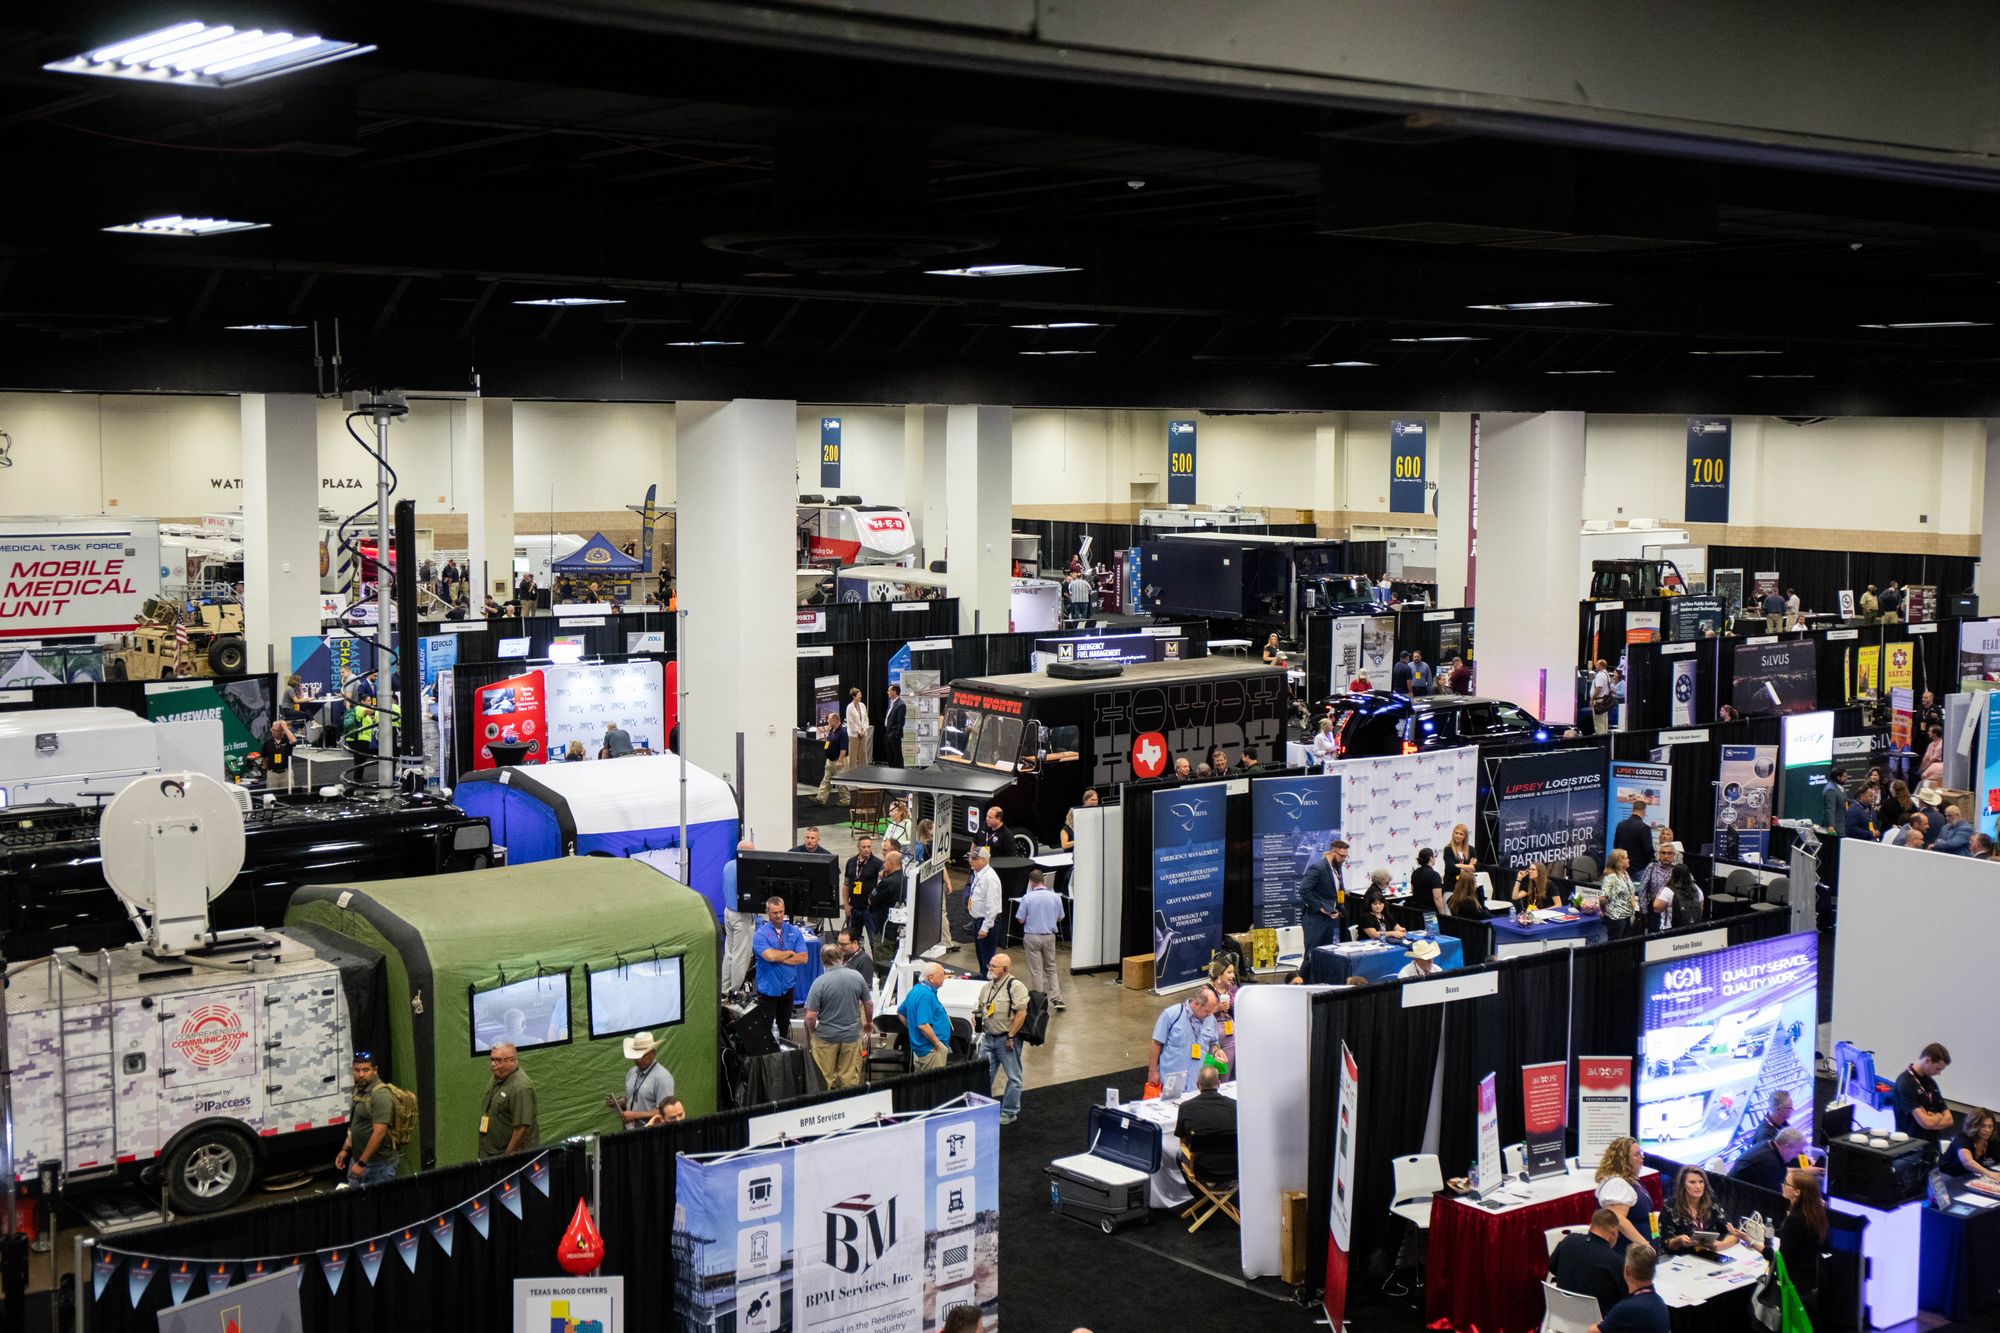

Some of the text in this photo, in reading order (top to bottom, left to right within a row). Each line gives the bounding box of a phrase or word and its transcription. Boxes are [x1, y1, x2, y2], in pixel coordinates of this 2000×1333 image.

[824, 444, 839, 462] 200
[1172, 452, 1193, 473] 500
[1395, 455, 1421, 478] 600
[1692, 458, 1724, 483] 700
[211, 478, 363, 489] WAT PLAZA
[10, 560, 124, 578] MOBILE
[4, 579, 137, 598] MEDICAL
[0, 600, 70, 618] UNIT
[439, 640, 453, 648] BOLD
[1077, 643, 1105, 651] EMERGENCY
[340, 640, 350, 667] CHA
[350, 640, 360, 675] MAKE
[1077, 649, 1121, 659] FUEL MANAGEMENT
[331, 640, 341, 690] HAPPEN
[953, 691, 1023, 715] FORT WORTH
[168, 707, 221, 723] SAFEWARE
[233, 741, 248, 750] Heroes
[1839, 740, 1857, 748] weaver
[1635, 769, 1664, 777] LOGISTICS
[1504, 792, 1536, 800] RESPONSE
[1542, 787, 1573, 796] RECOVERY
[1574, 783, 1601, 791] SERVICES
[1505, 774, 1601, 794] LIPSEY LOGISTICS
[937, 831, 950, 855] 40
[1504, 826, 1594, 853] POSITIONED FOR
[1160, 848, 1219, 863] EMERGENCY MANAGEMENT
[1510, 844, 1587, 869] PARTNERSHIP
[1160, 866, 1218, 881] GOVERNMENT OPERATIONS
[1169, 878, 1178, 886] AND
[1166, 892, 1212, 905] GRANT MANAGEMENT
[1170, 913, 1199, 923] TECHNOLOGY
[1176, 918, 1202, 927] INNOVATION
[1173, 933, 1206, 945] GRANT WRITING
[1672, 940, 1703, 952] Safeside Global
[1722, 954, 1809, 983] QUALITY SERVICE
[1722, 971, 1799, 997] QUALITY WORK
[171, 1031, 249, 1049] COMMUNICATION
[175, 1026, 241, 1042] COMPREHENSIVE
[171, 1088, 233, 1103] Satellite Powered by:
[204, 1097, 251, 1113] IPaccess
[800, 1110, 846, 1128] BPM Services
[750, 1203, 772, 1212] Dumpsters
[566, 1252, 594, 1260] READINESS
[529, 1287, 608, 1297] TEXAS BLOOD CENTERS
[806, 1273, 913, 1309] BPM Services, Inc.
[856, 1320, 869, 1330] the
[871, 1308, 916, 1326] Restoration
